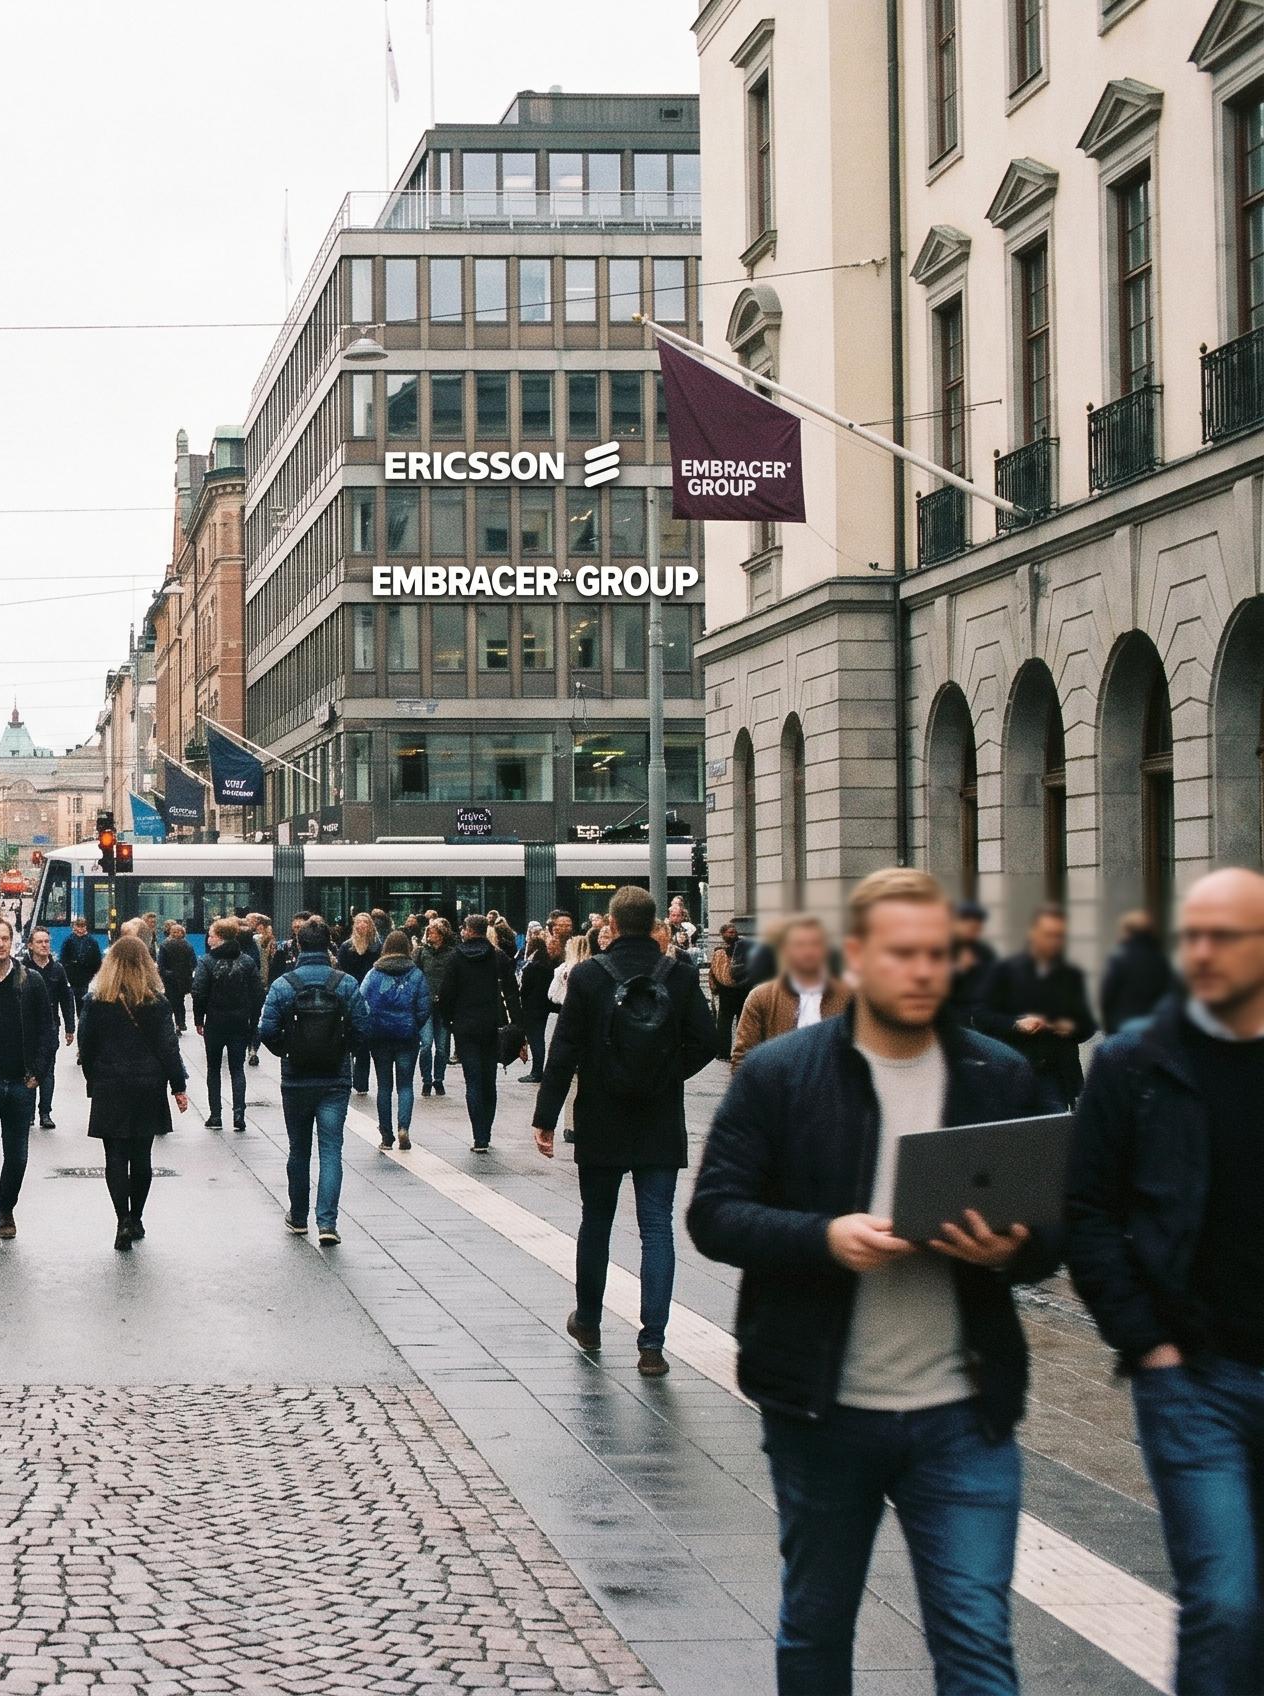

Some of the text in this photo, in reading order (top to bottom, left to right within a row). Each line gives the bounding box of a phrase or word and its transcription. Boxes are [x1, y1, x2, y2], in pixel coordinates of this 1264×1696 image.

[384, 451, 565, 480] ERICSSON
[687, 478, 757, 497] GROUP
[372, 565, 699, 597] EMBRACER GROUP
